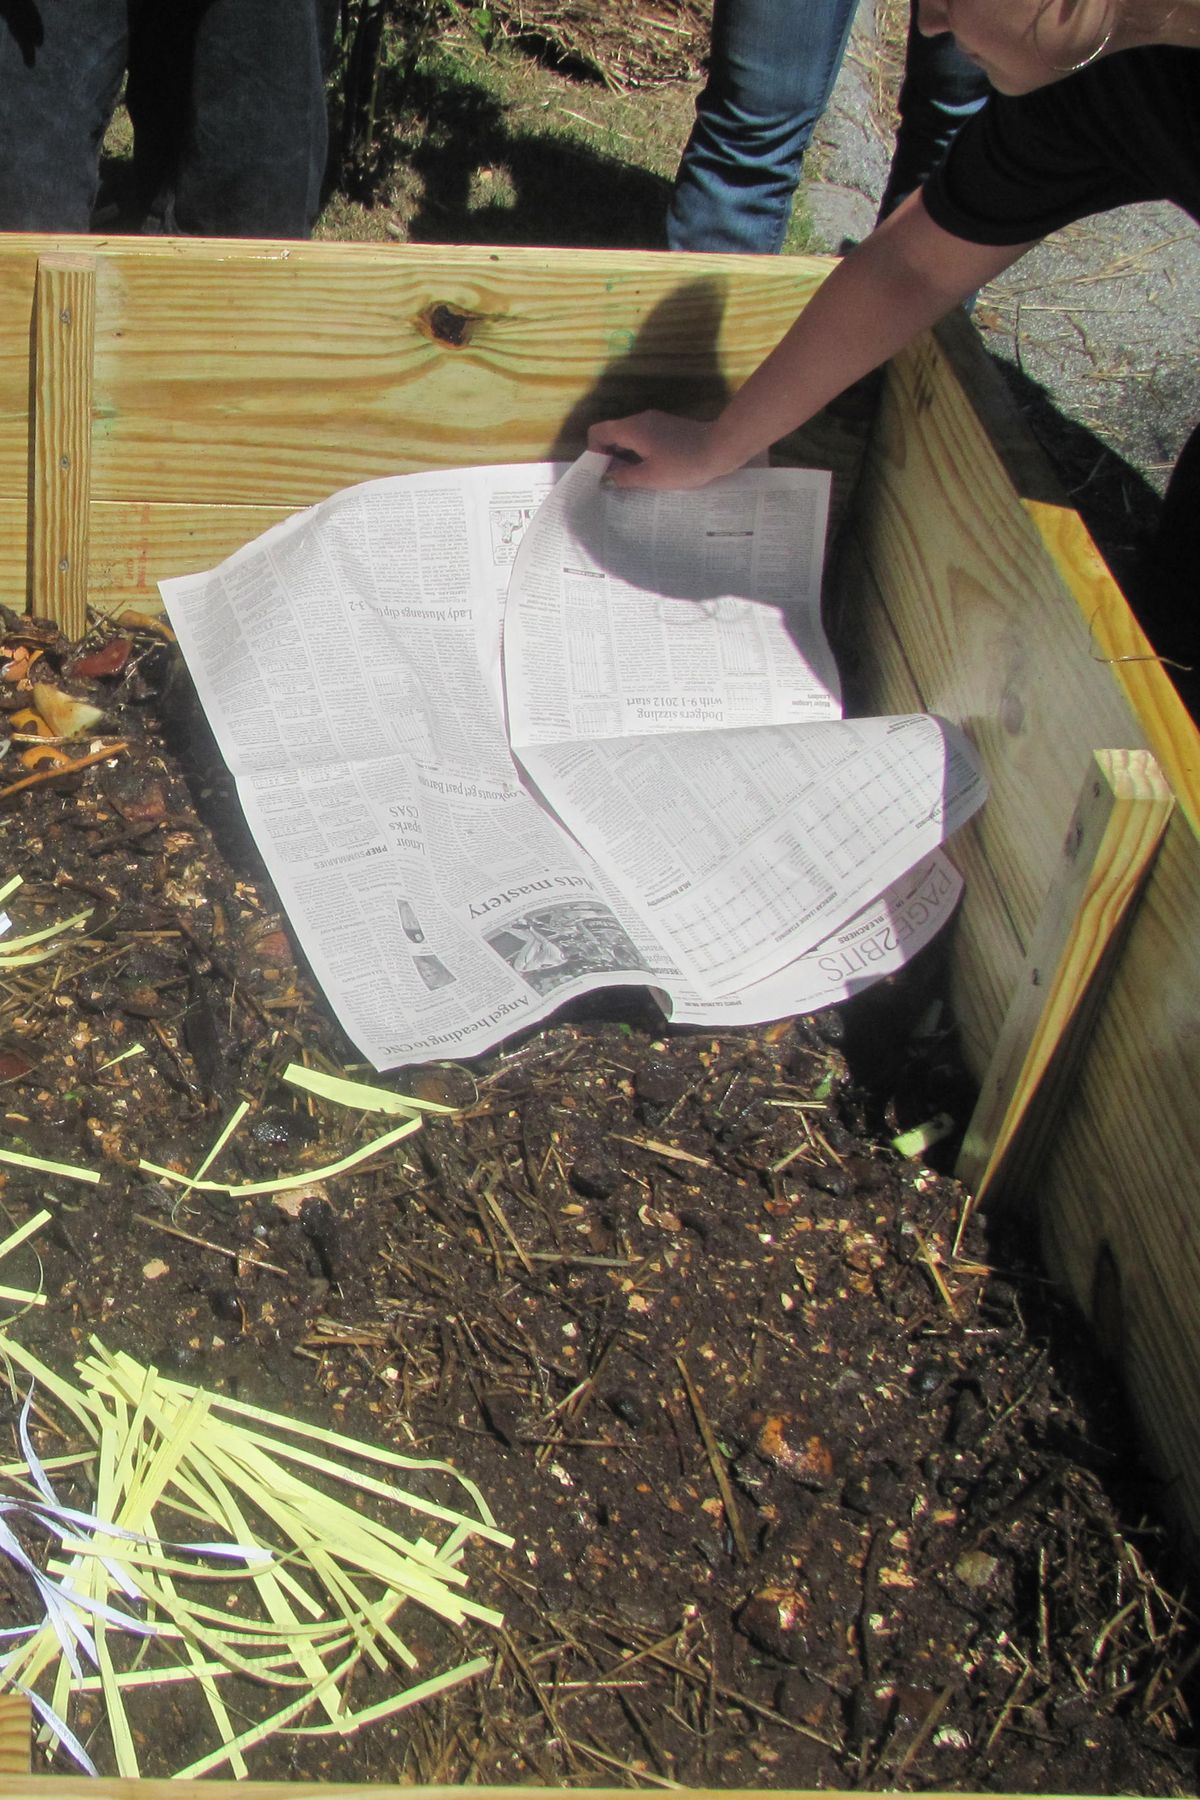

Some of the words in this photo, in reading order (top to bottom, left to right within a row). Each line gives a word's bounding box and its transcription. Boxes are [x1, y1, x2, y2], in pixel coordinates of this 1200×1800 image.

[348, 600, 364, 610] 3-2
[401, 608, 444, 620] Mustangs
[447, 607, 472, 619] Lady
[626, 697, 650, 706] start
[652, 696, 678, 706] 2012
[680, 697, 696, 706] 9-1
[698, 696, 722, 707] with
[636, 708, 676, 719] sizzling
[679, 708, 722, 721] Dodgers
[445, 783, 463, 795] past
[463, 785, 477, 796] get
[478, 789, 524, 800] Lookouts
[388, 806, 418, 817] CSAS
[395, 838, 425, 854] Lenoir
[468, 878, 551, 919] mastery
[815, 890, 837, 911] AMERICAN
[837, 915, 884, 944] BLEACHERS
[485, 993, 529, 1025] Angel
[427, 1017, 489, 1050] heading
[378, 1040, 413, 1055] CNC
[413, 1038, 429, 1049] to
